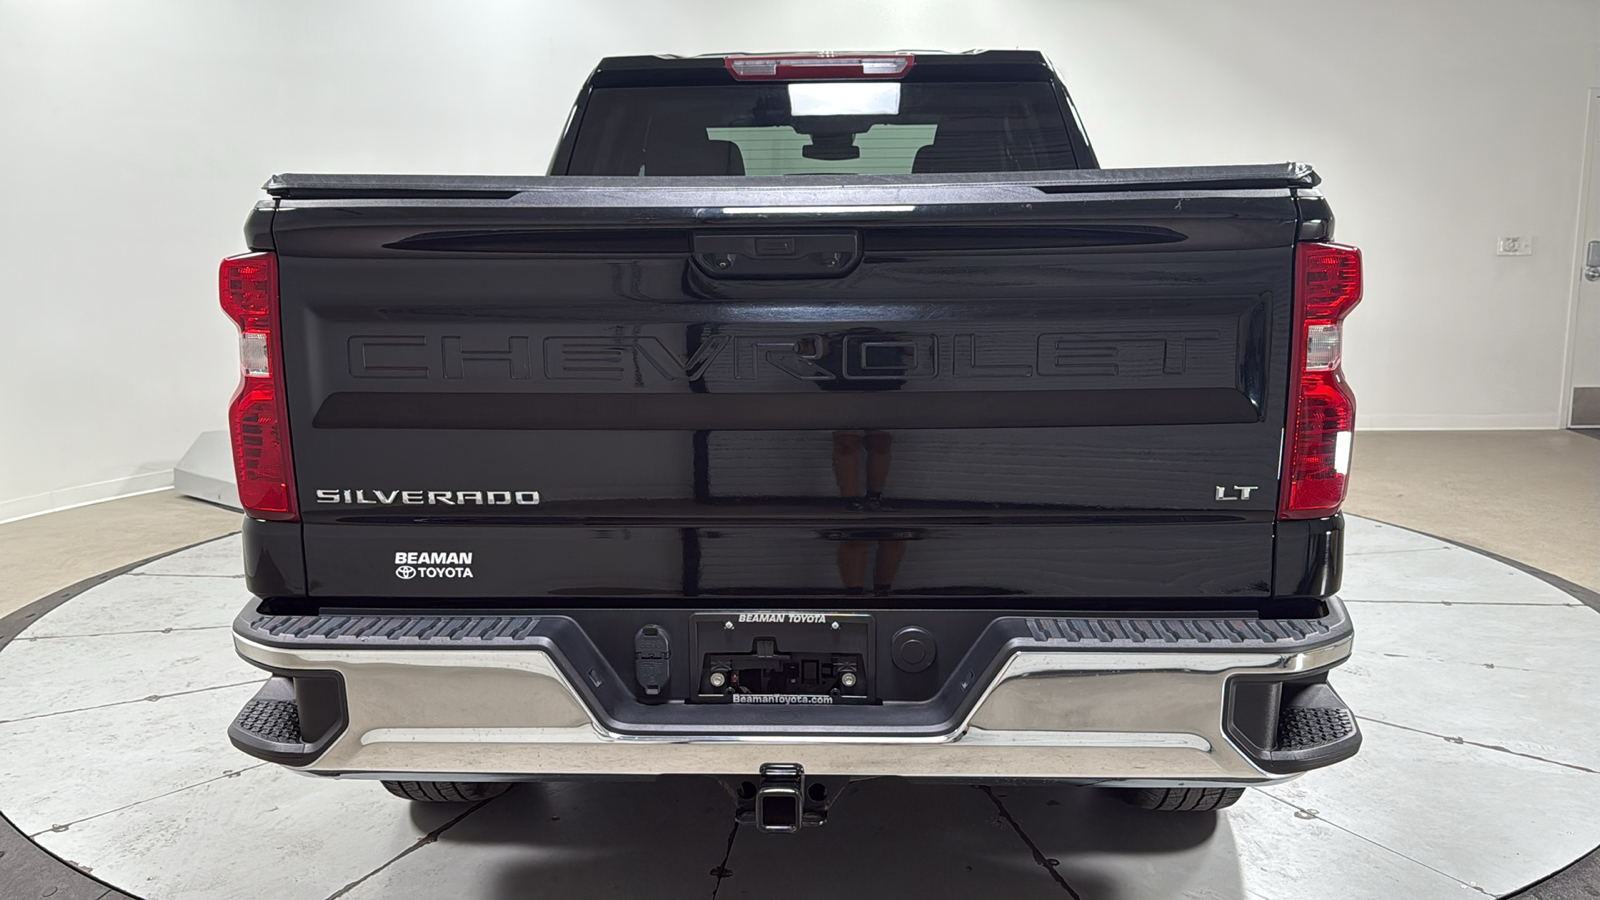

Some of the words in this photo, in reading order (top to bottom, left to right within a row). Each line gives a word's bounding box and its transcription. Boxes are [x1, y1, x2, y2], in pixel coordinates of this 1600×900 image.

[347, 329, 1221, 381] CHEVROLET
[316, 489, 540, 505] SILVERADO
[1215, 485, 1258, 501] LT
[395, 552, 473, 565] BEAMAN
[418, 567, 473, 578] TOYOTA
[738, 614, 784, 623] BEAMAN
[788, 614, 826, 623] TOYOTA
[732, 694, 833, 705] BeamanToyota.com
